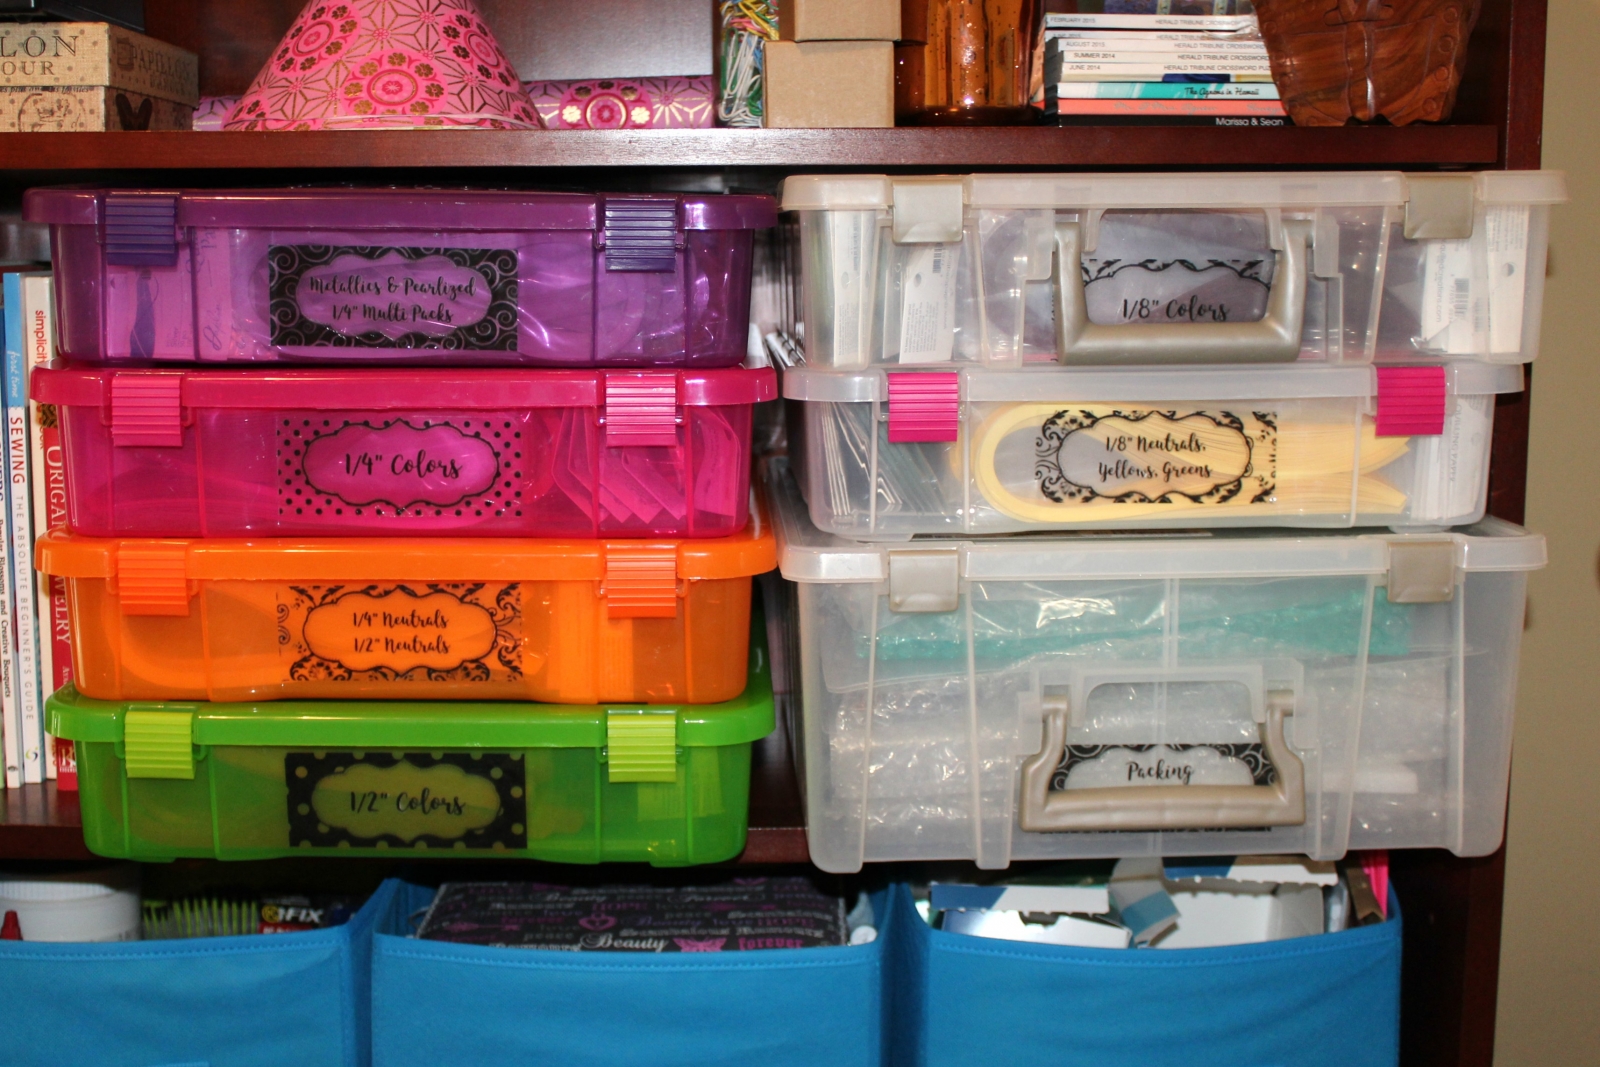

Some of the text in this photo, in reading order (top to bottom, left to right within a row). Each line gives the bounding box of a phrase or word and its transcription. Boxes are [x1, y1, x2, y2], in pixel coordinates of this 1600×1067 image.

[1184, 87, 1198, 95] The
[1215, 117, 1284, 126] Marissa & Sean
[309, 276, 476, 300] Metallics & Pearlized
[332, 304, 454, 323] 1/4" Multi Packs
[1122, 294, 1230, 322] 1/8" Colors
[34, 310, 48, 365] simplicity
[7, 350, 20, 374] first
[11, 377, 20, 398] time
[10, 416, 26, 484] SEWING
[1105, 436, 1133, 452] 1/8"
[344, 449, 463, 479] 1/4" Colors
[1162, 461, 1212, 483] Greens
[0, 600, 8, 615] and
[16, 496, 34, 720] THE ABSOLUTE BEGINNER'S GUIDE
[353, 609, 449, 628] 1/4" Neutrals
[1, 619, 9, 655] Creative
[354, 635, 450, 654] 1/2" Neutrals
[3, 659, 11, 698] Bouquets
[1125, 758, 1195, 785] Packing
[350, 787, 466, 816] 1/2" Colors
[580, 931, 669, 953] Beauty
[737, 937, 805, 951] forever
